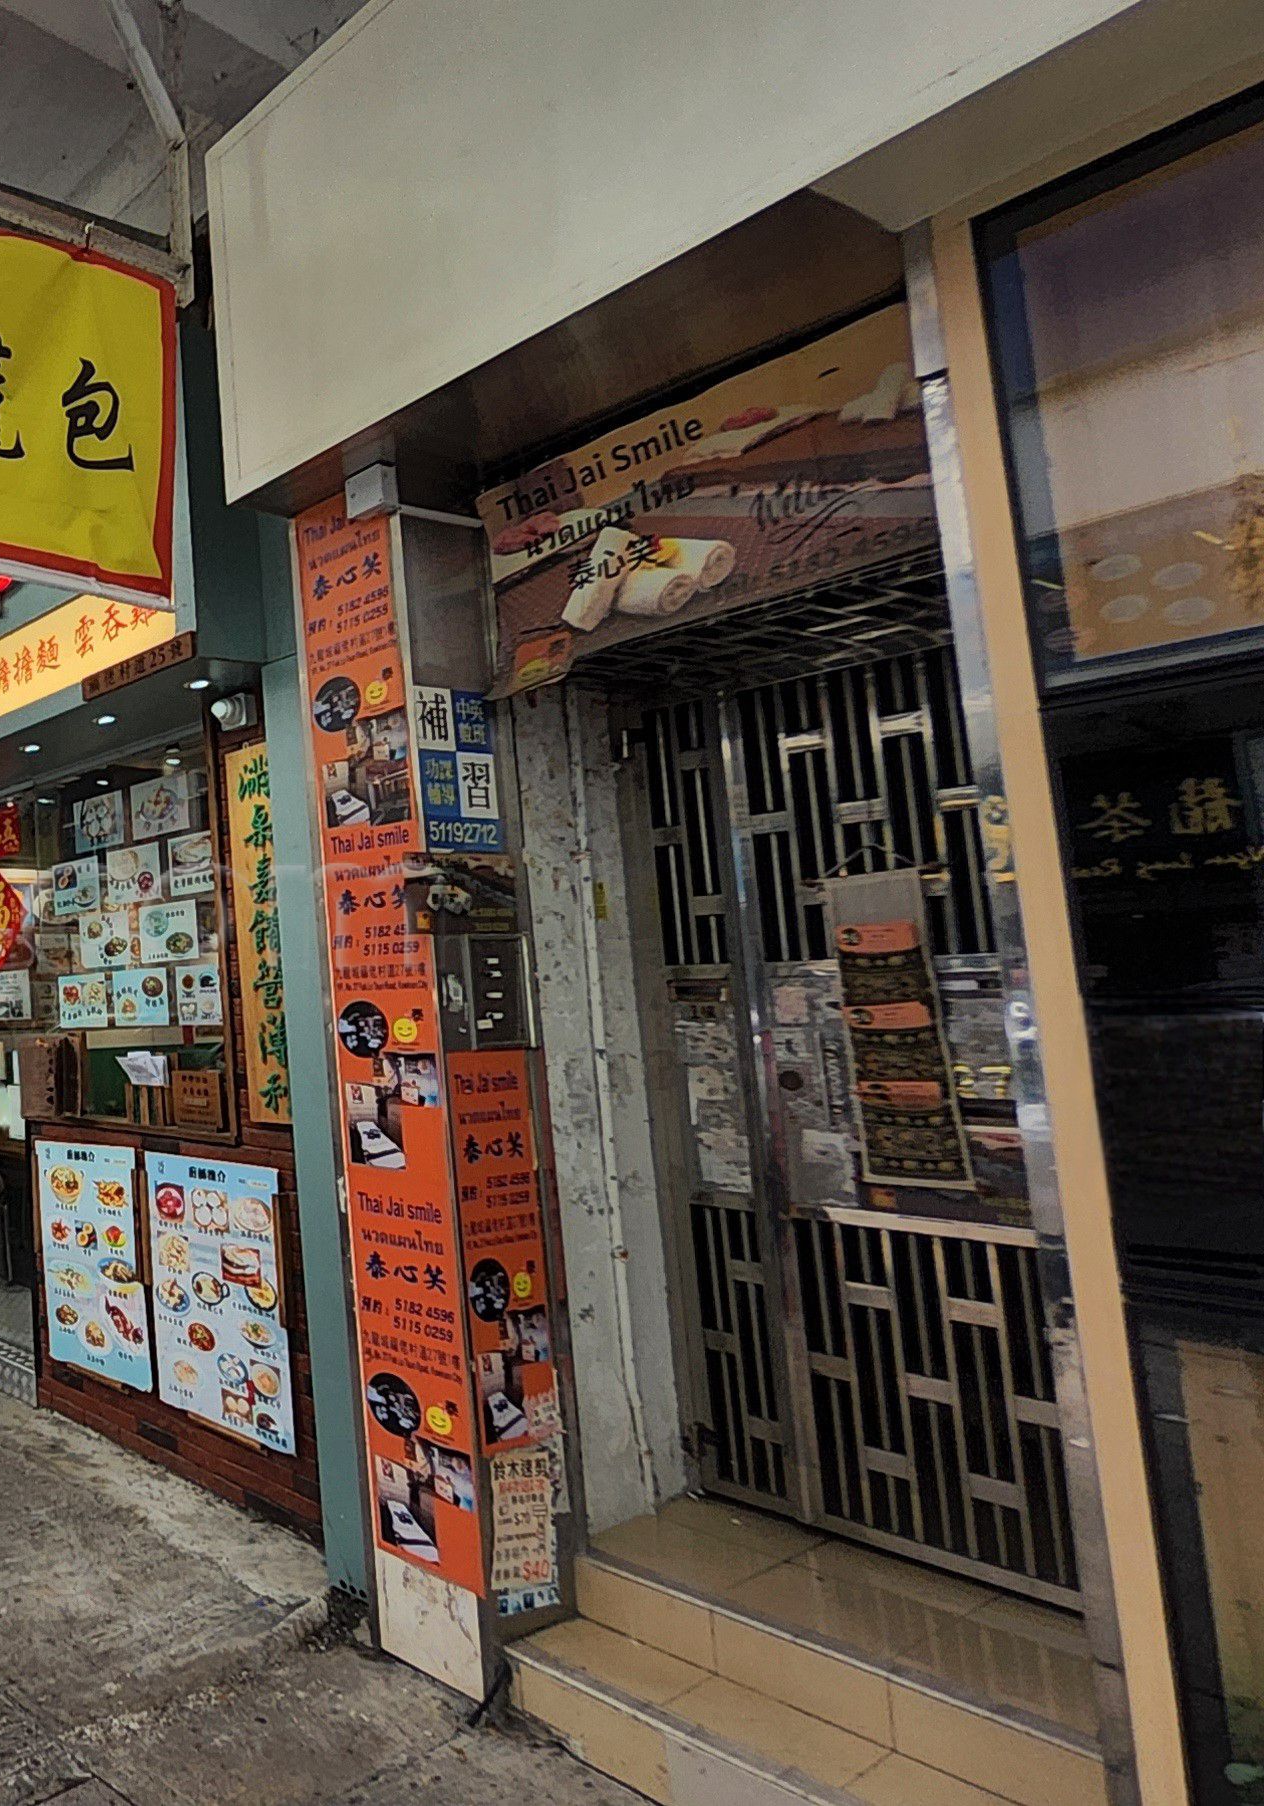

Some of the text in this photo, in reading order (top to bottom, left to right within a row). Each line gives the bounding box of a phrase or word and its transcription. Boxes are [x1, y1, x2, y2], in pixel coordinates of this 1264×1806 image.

[495, 416, 704, 521] Thai Jai Smile
[313, 552, 382, 601] 泰心笑
[568, 533, 657, 590] 泰心笑
[416, 691, 449, 742] 補
[462, 762, 491, 809] 習
[331, 827, 410, 855] Thai Jai smile
[429, 821, 499, 845] 51192712
[463, 1131, 524, 1164] 泰心笑
[357, 1191, 443, 1225] Thai Jai smile
[365, 1250, 447, 1295] 泰心笑
[393, 1316, 422, 1335] 5115
[394, 1298, 424, 1317] 5182
